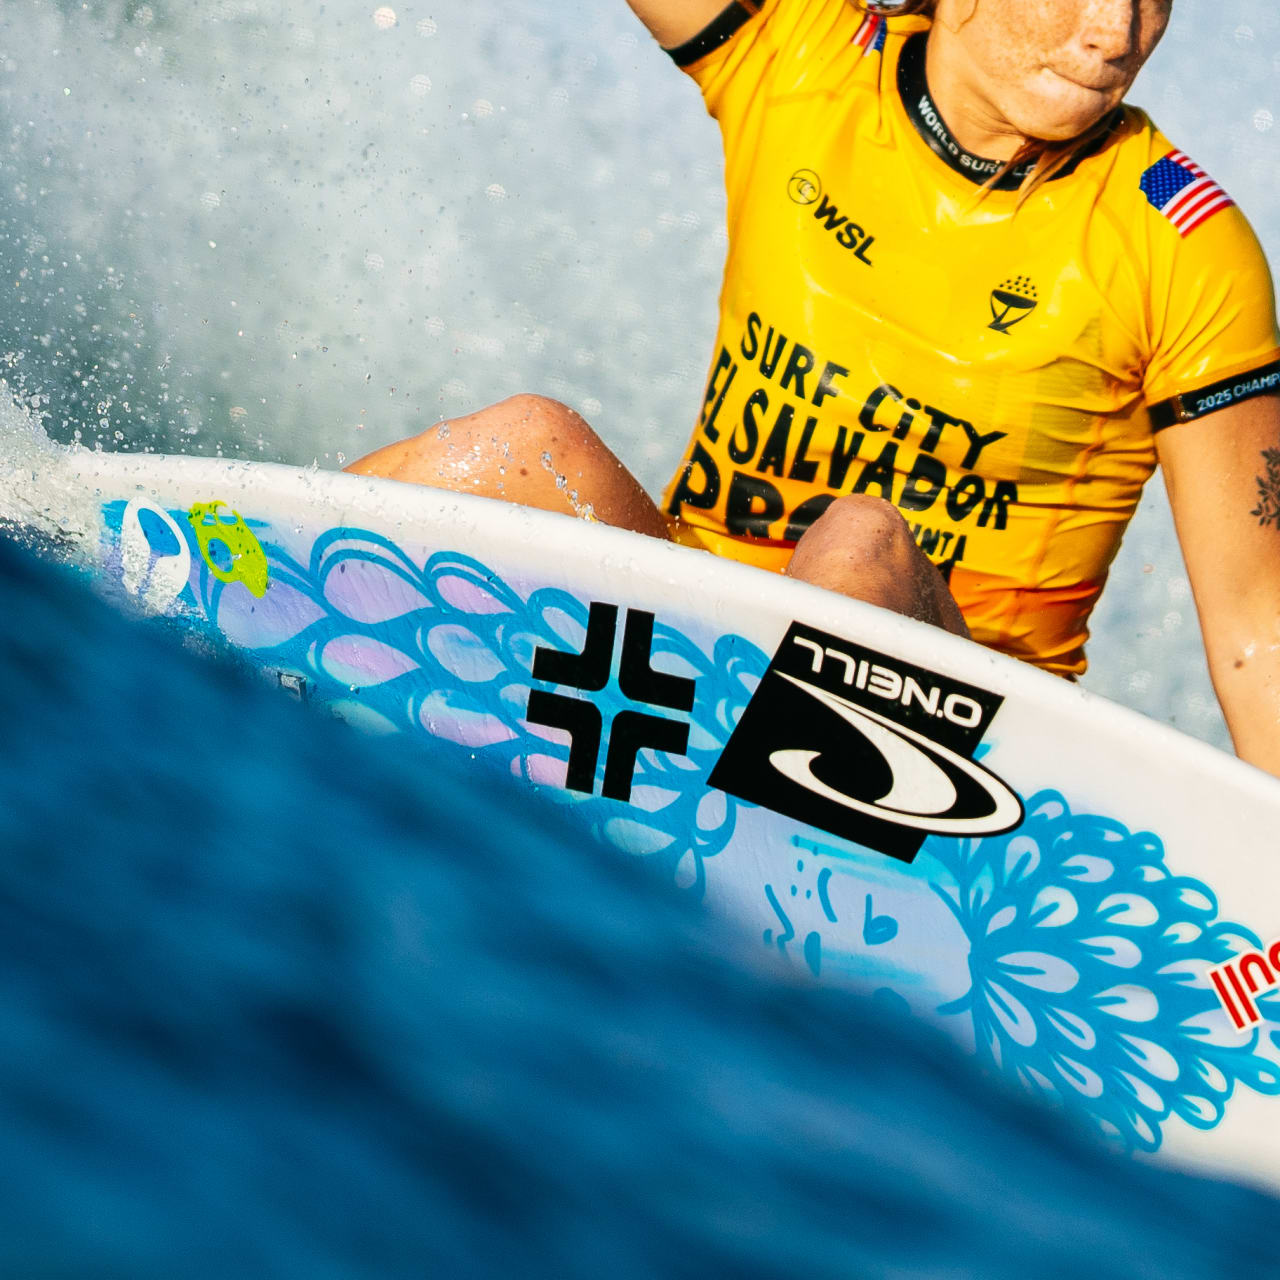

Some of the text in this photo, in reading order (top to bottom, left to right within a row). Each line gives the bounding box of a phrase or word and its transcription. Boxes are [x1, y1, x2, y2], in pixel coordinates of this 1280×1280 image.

[918, 94, 959, 156] WORLD
[814, 193, 875, 267] WSL
[740, 312, 850, 408] SURF
[1195, 388, 1232, 412] 2025
[701, 343, 1019, 531] EL SALVADOR
[793, 635, 983, 729] O'NEILL
